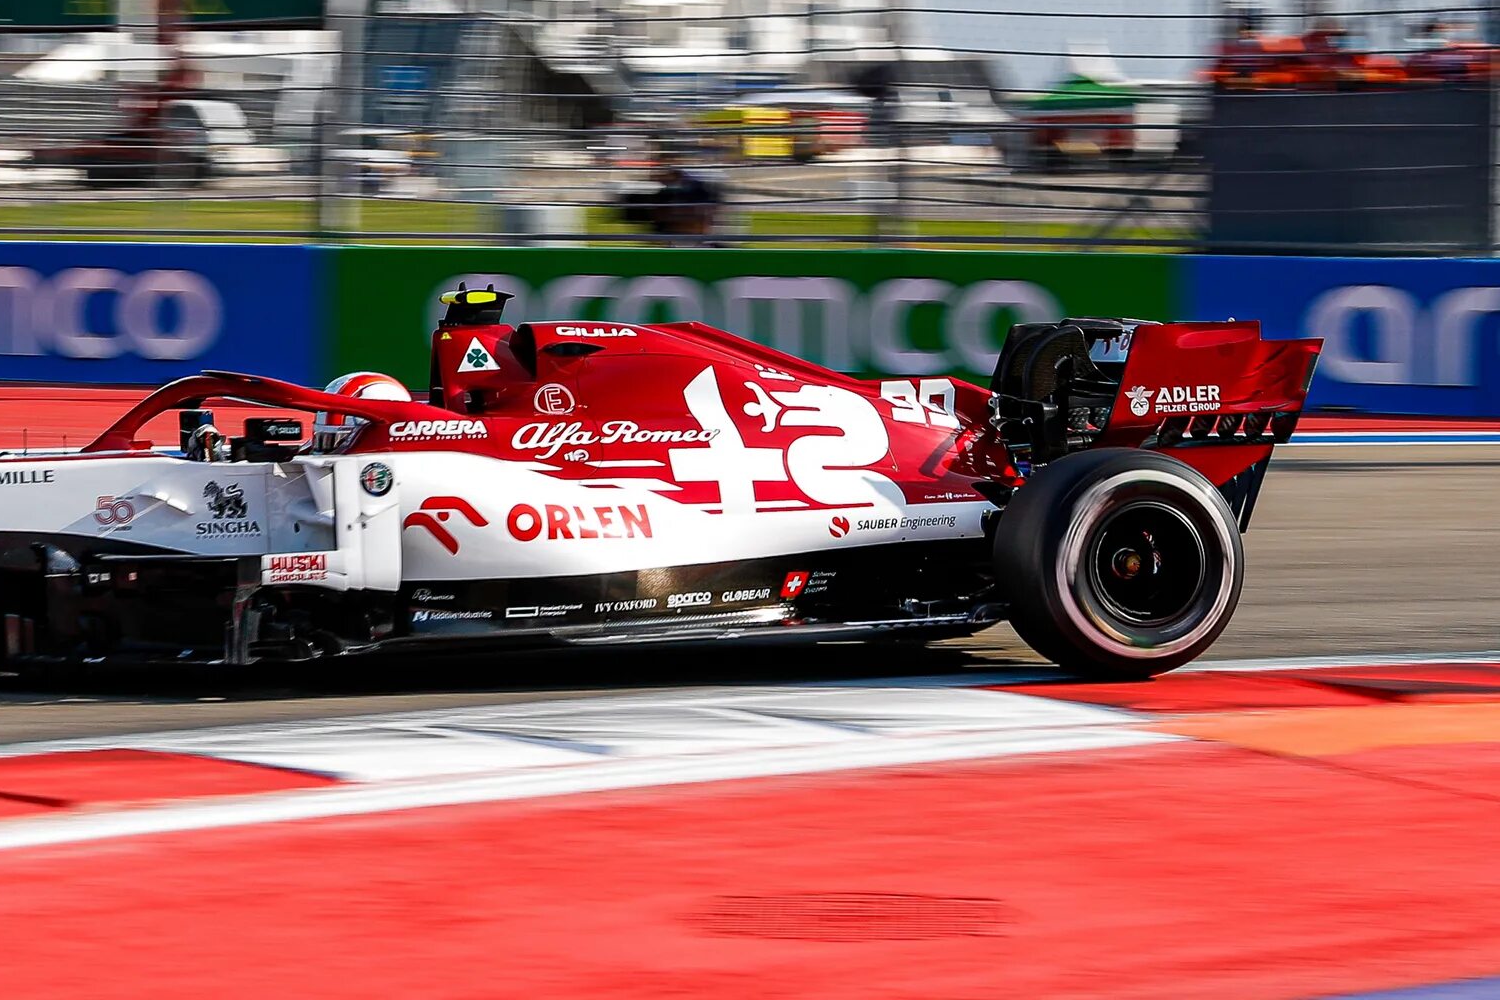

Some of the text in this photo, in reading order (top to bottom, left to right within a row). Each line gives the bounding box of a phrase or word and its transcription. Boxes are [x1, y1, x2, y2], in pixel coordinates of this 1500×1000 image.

[555, 326, 638, 337] GIULIA
[1155, 385, 1220, 403] ADLER
[1155, 402, 1221, 414] PELZER GROUP
[388, 420, 488, 437] CARRERA
[511, 420, 721, 460] Alfa Romeo
[196, 520, 261, 535] SINGHA
[507, 503, 653, 542] ORLEN
[857, 514, 956, 531] SAUBER Engineering
[270, 554, 328, 572] HUSKI
[667, 591, 712, 608] sparco
[722, 588, 771, 602] GLOBEAIR
[614, 598, 657, 611] OXFORD
